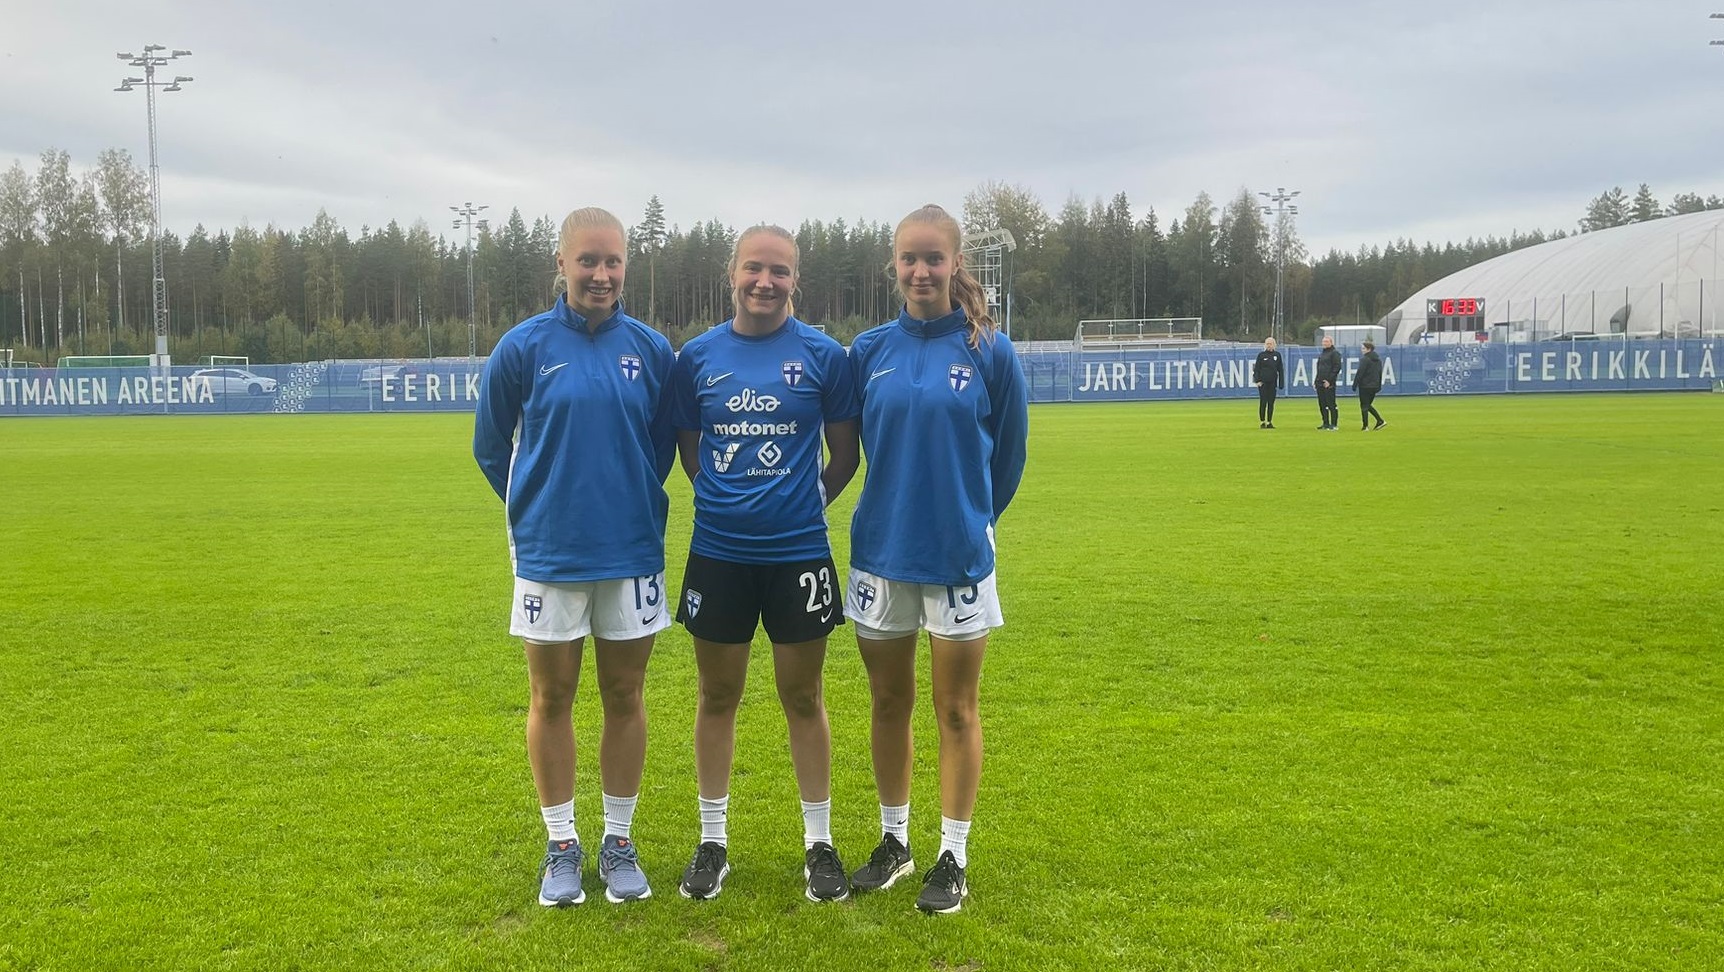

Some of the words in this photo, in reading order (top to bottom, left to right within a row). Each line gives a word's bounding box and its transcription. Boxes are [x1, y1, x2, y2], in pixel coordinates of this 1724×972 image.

[1428, 302, 1437, 312] K
[1476, 301, 1484, 311] V
[1078, 362, 1136, 392] JARI
[1149, 359, 1259, 390] LITMANE
[1517, 343, 1716, 382] EERIKKILÄ
[0, 377, 107, 405] ITMANEN
[118, 376, 215, 404] AREENA
[382, 373, 480, 402] EERIK
[725, 387, 781, 413] elisa
[712, 420, 798, 436] motonet
[747, 467, 792, 477] LÄHITAPIOLA
[633, 573, 660, 610] 13
[799, 567, 832, 613] 23
